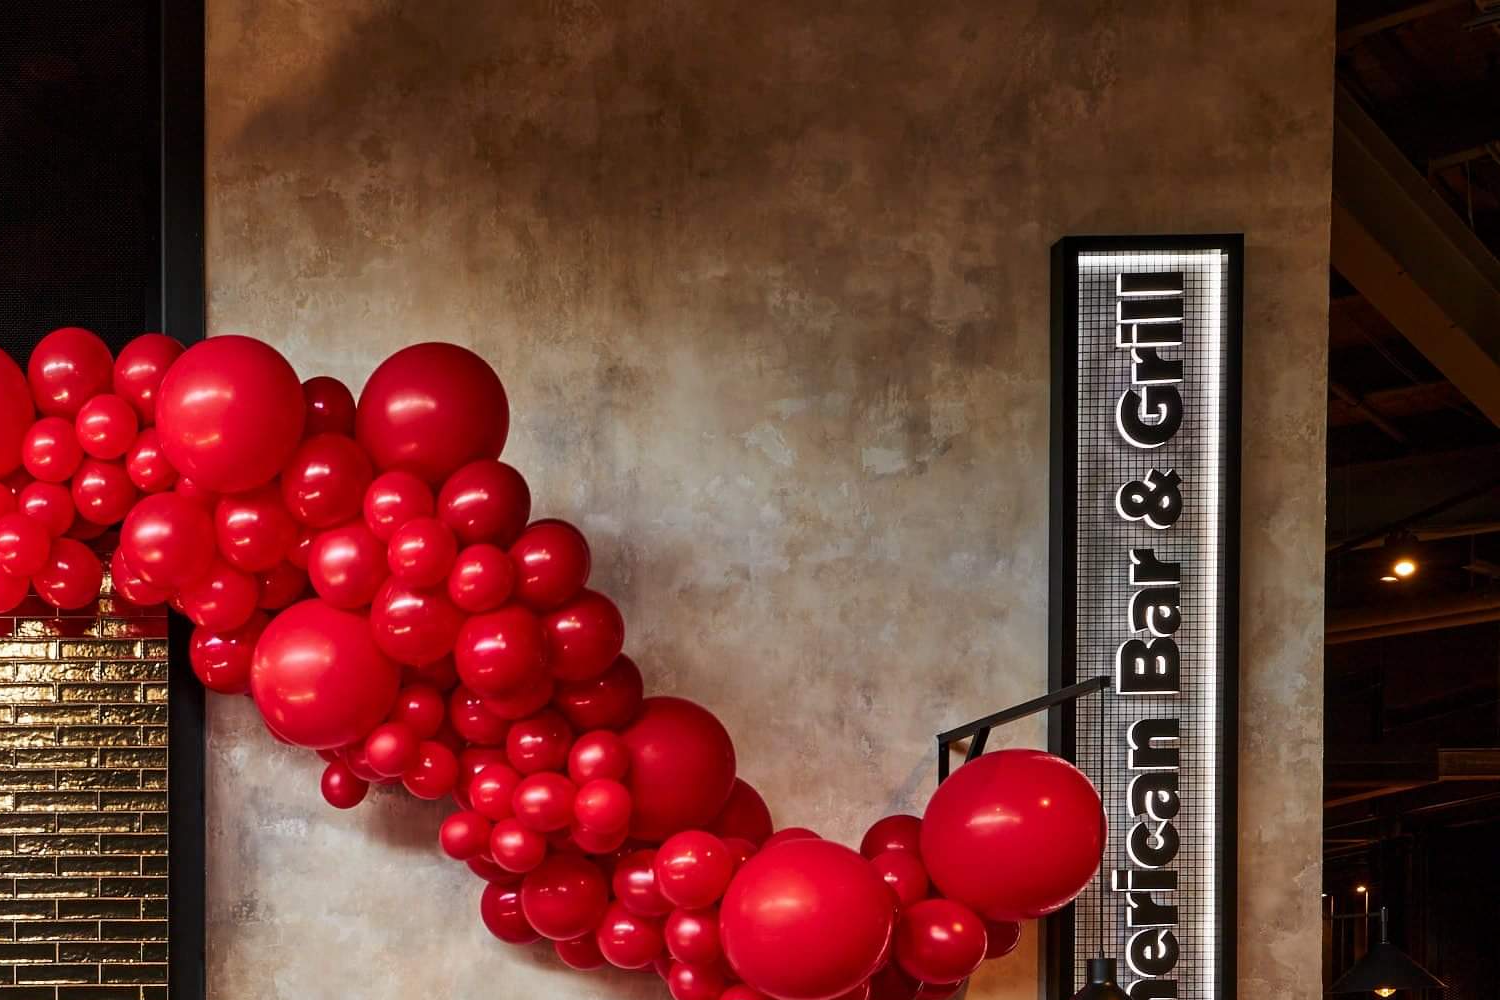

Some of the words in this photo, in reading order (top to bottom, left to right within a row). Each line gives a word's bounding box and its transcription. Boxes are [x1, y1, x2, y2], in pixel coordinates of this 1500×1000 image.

[1116, 271, 1184, 448] Grill
[1116, 468, 1182, 530] &
[1116, 548, 1182, 694] Bar
